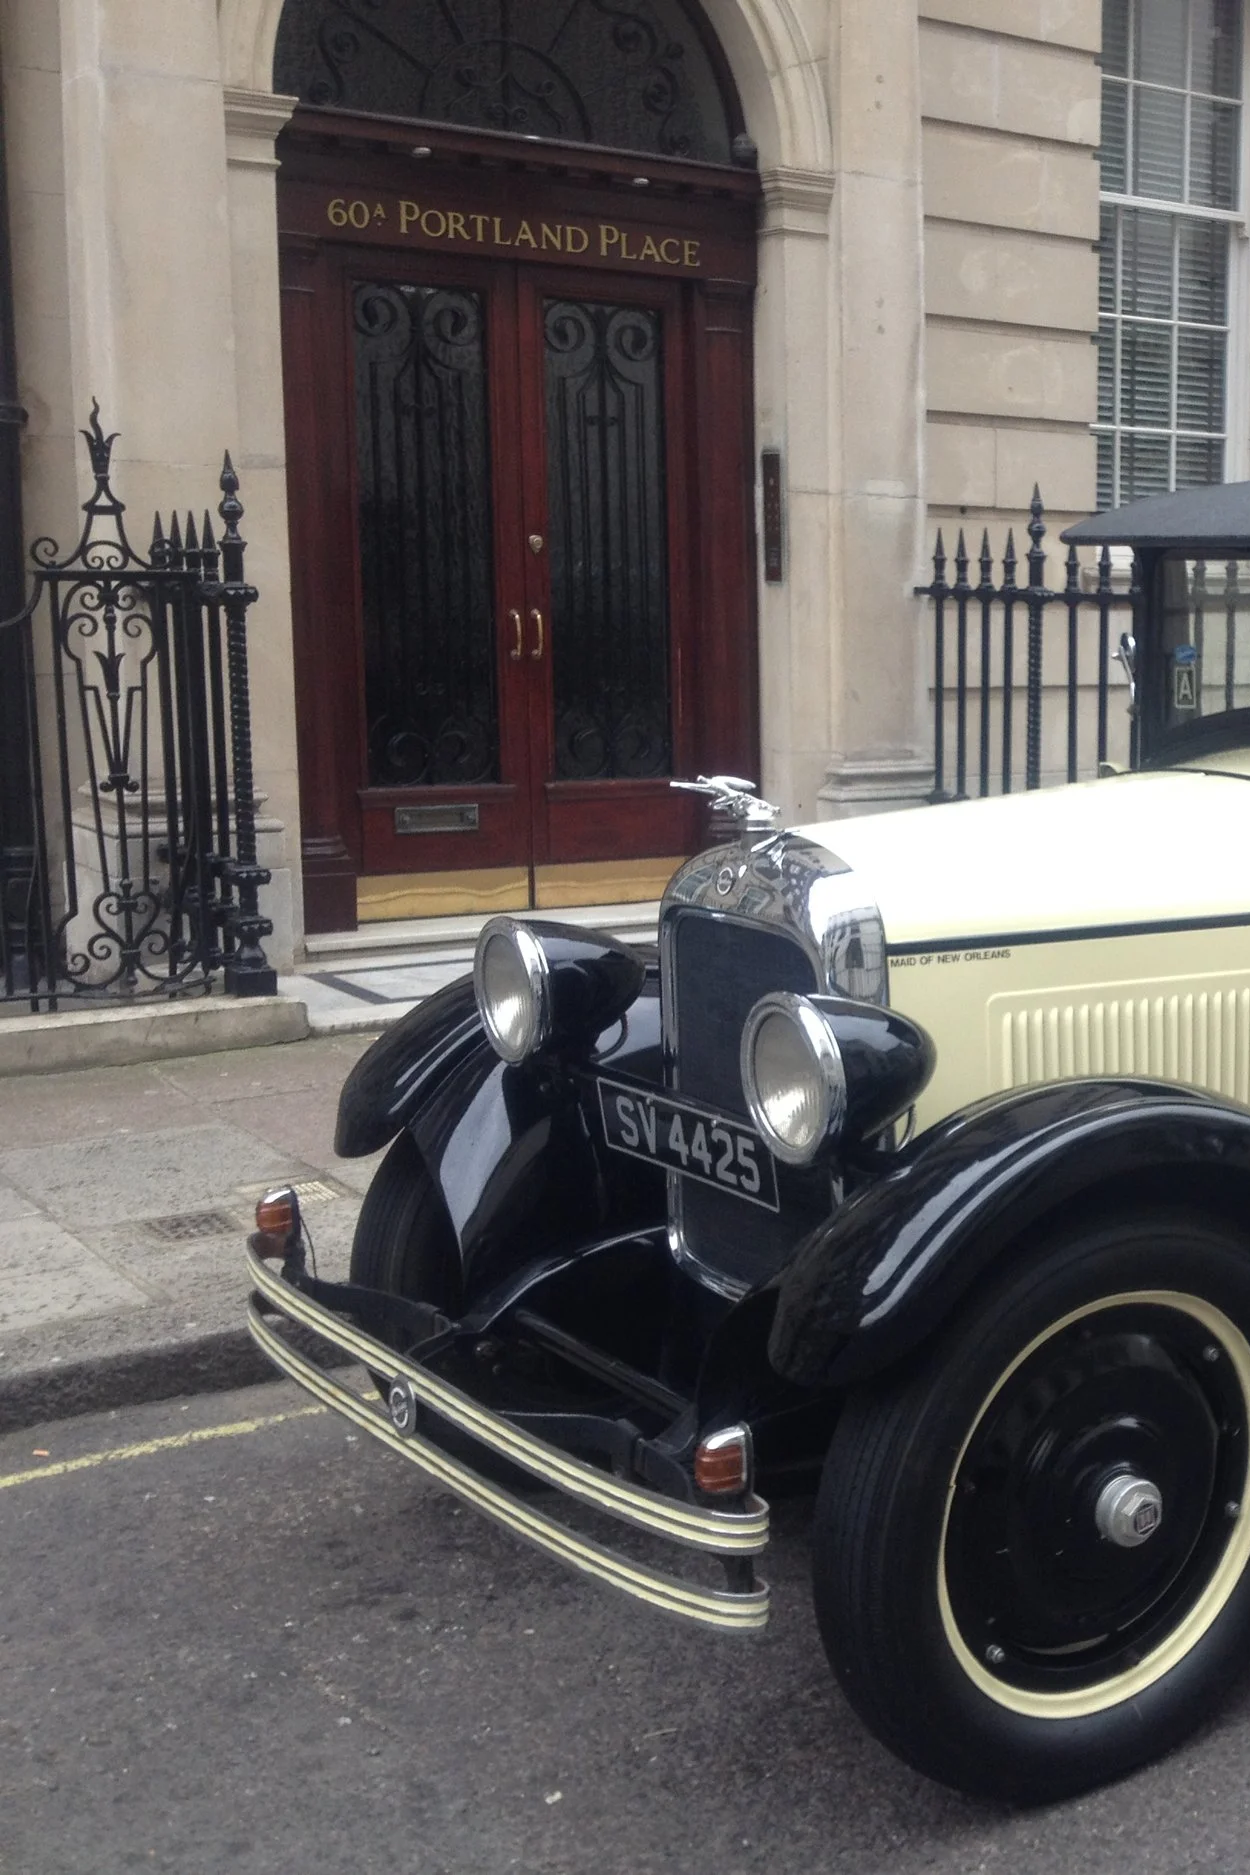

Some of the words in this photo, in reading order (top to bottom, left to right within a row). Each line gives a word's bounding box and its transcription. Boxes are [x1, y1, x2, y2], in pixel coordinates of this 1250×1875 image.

[399, 200, 589, 253] PORTLAND
[600, 224, 700, 267] PLACE
[1179, 672, 1192, 700] A
[890, 957, 916, 968] MAID
[920, 955, 934, 965] OF
[937, 953, 960, 964] NEW
[964, 949, 1011, 961] ORLEANS
[616, 1095, 656, 1154] SV
[668, 1113, 760, 1193] 4425
